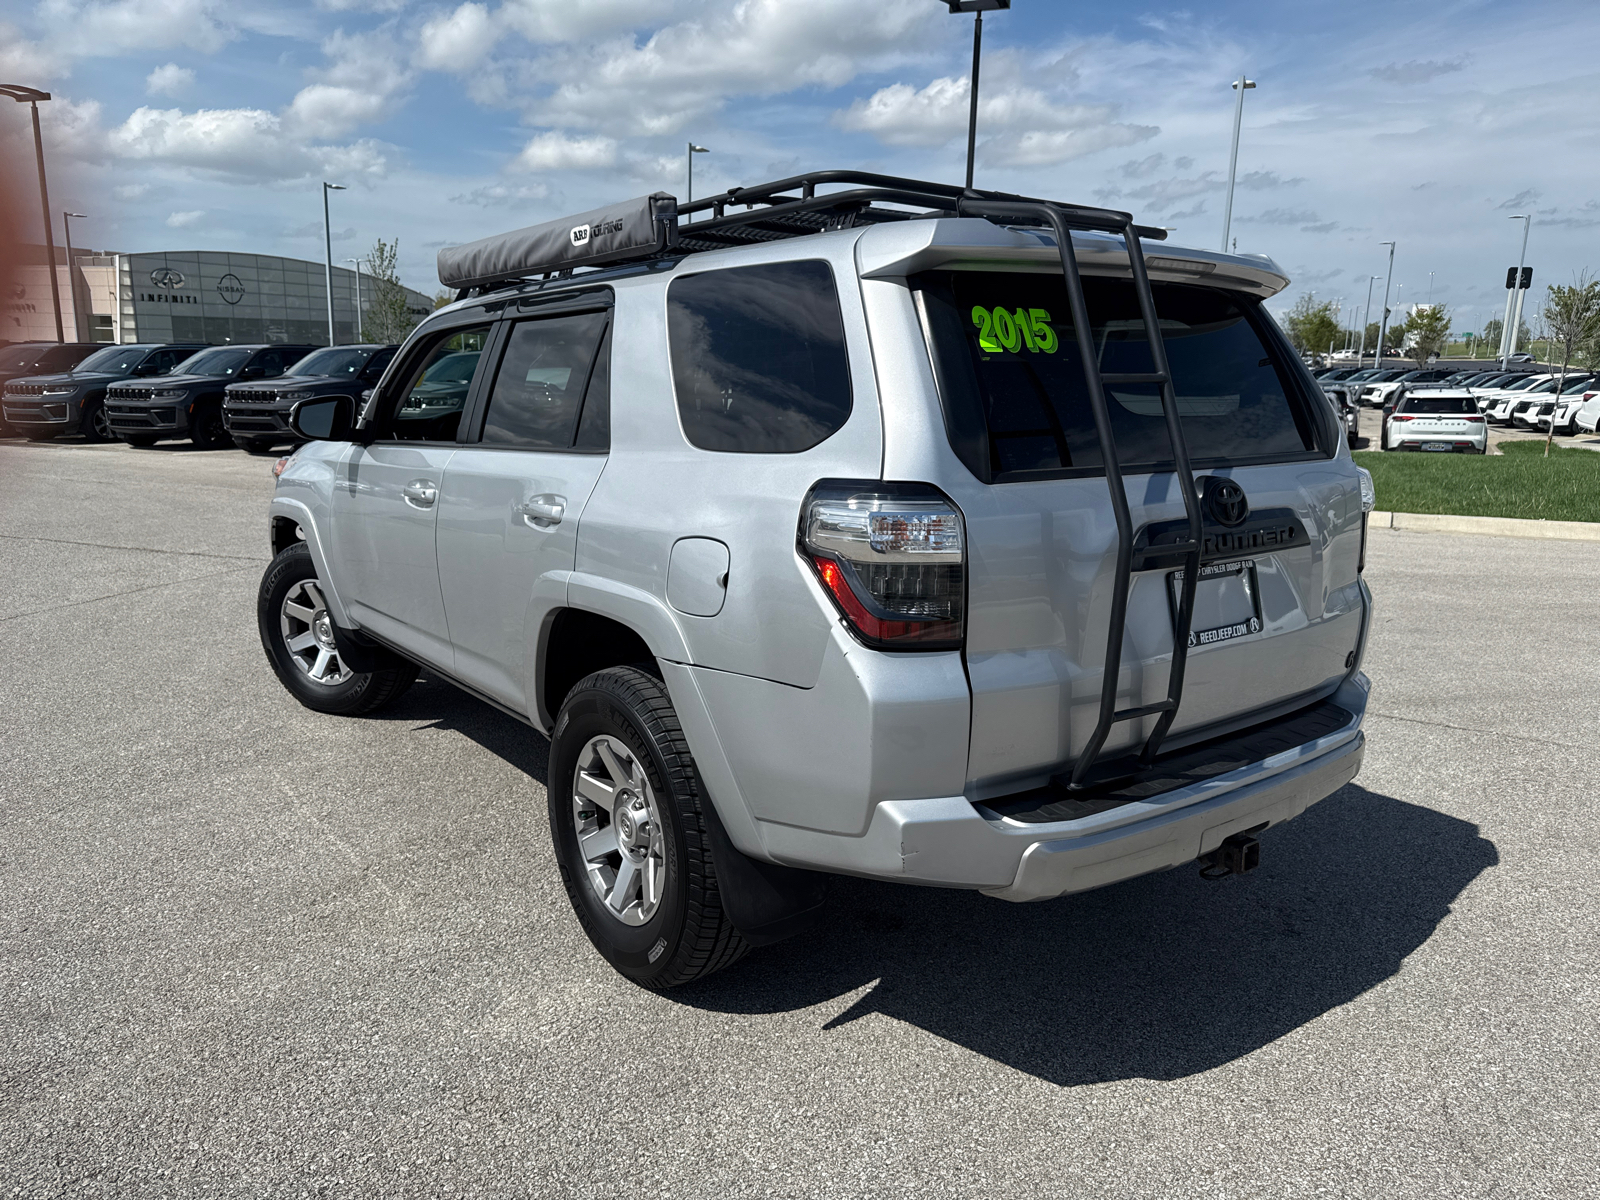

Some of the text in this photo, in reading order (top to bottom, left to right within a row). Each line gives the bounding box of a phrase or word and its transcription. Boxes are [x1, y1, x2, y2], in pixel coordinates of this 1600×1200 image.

[573, 218, 623, 242] ARB TOURING
[140, 293, 197, 304] INFINITI
[216, 285, 246, 293] NISSAN
[972, 305, 1059, 354] 2015
[1175, 526, 1287, 556] RUNNER
[1201, 564, 1226, 576] CHRYSLER
[1226, 561, 1241, 572] DODGE
[1241, 560, 1254, 569] RAM
[1199, 623, 1247, 644] REEDJEEP.COM
[612, 710, 662, 789] MICHELIN
